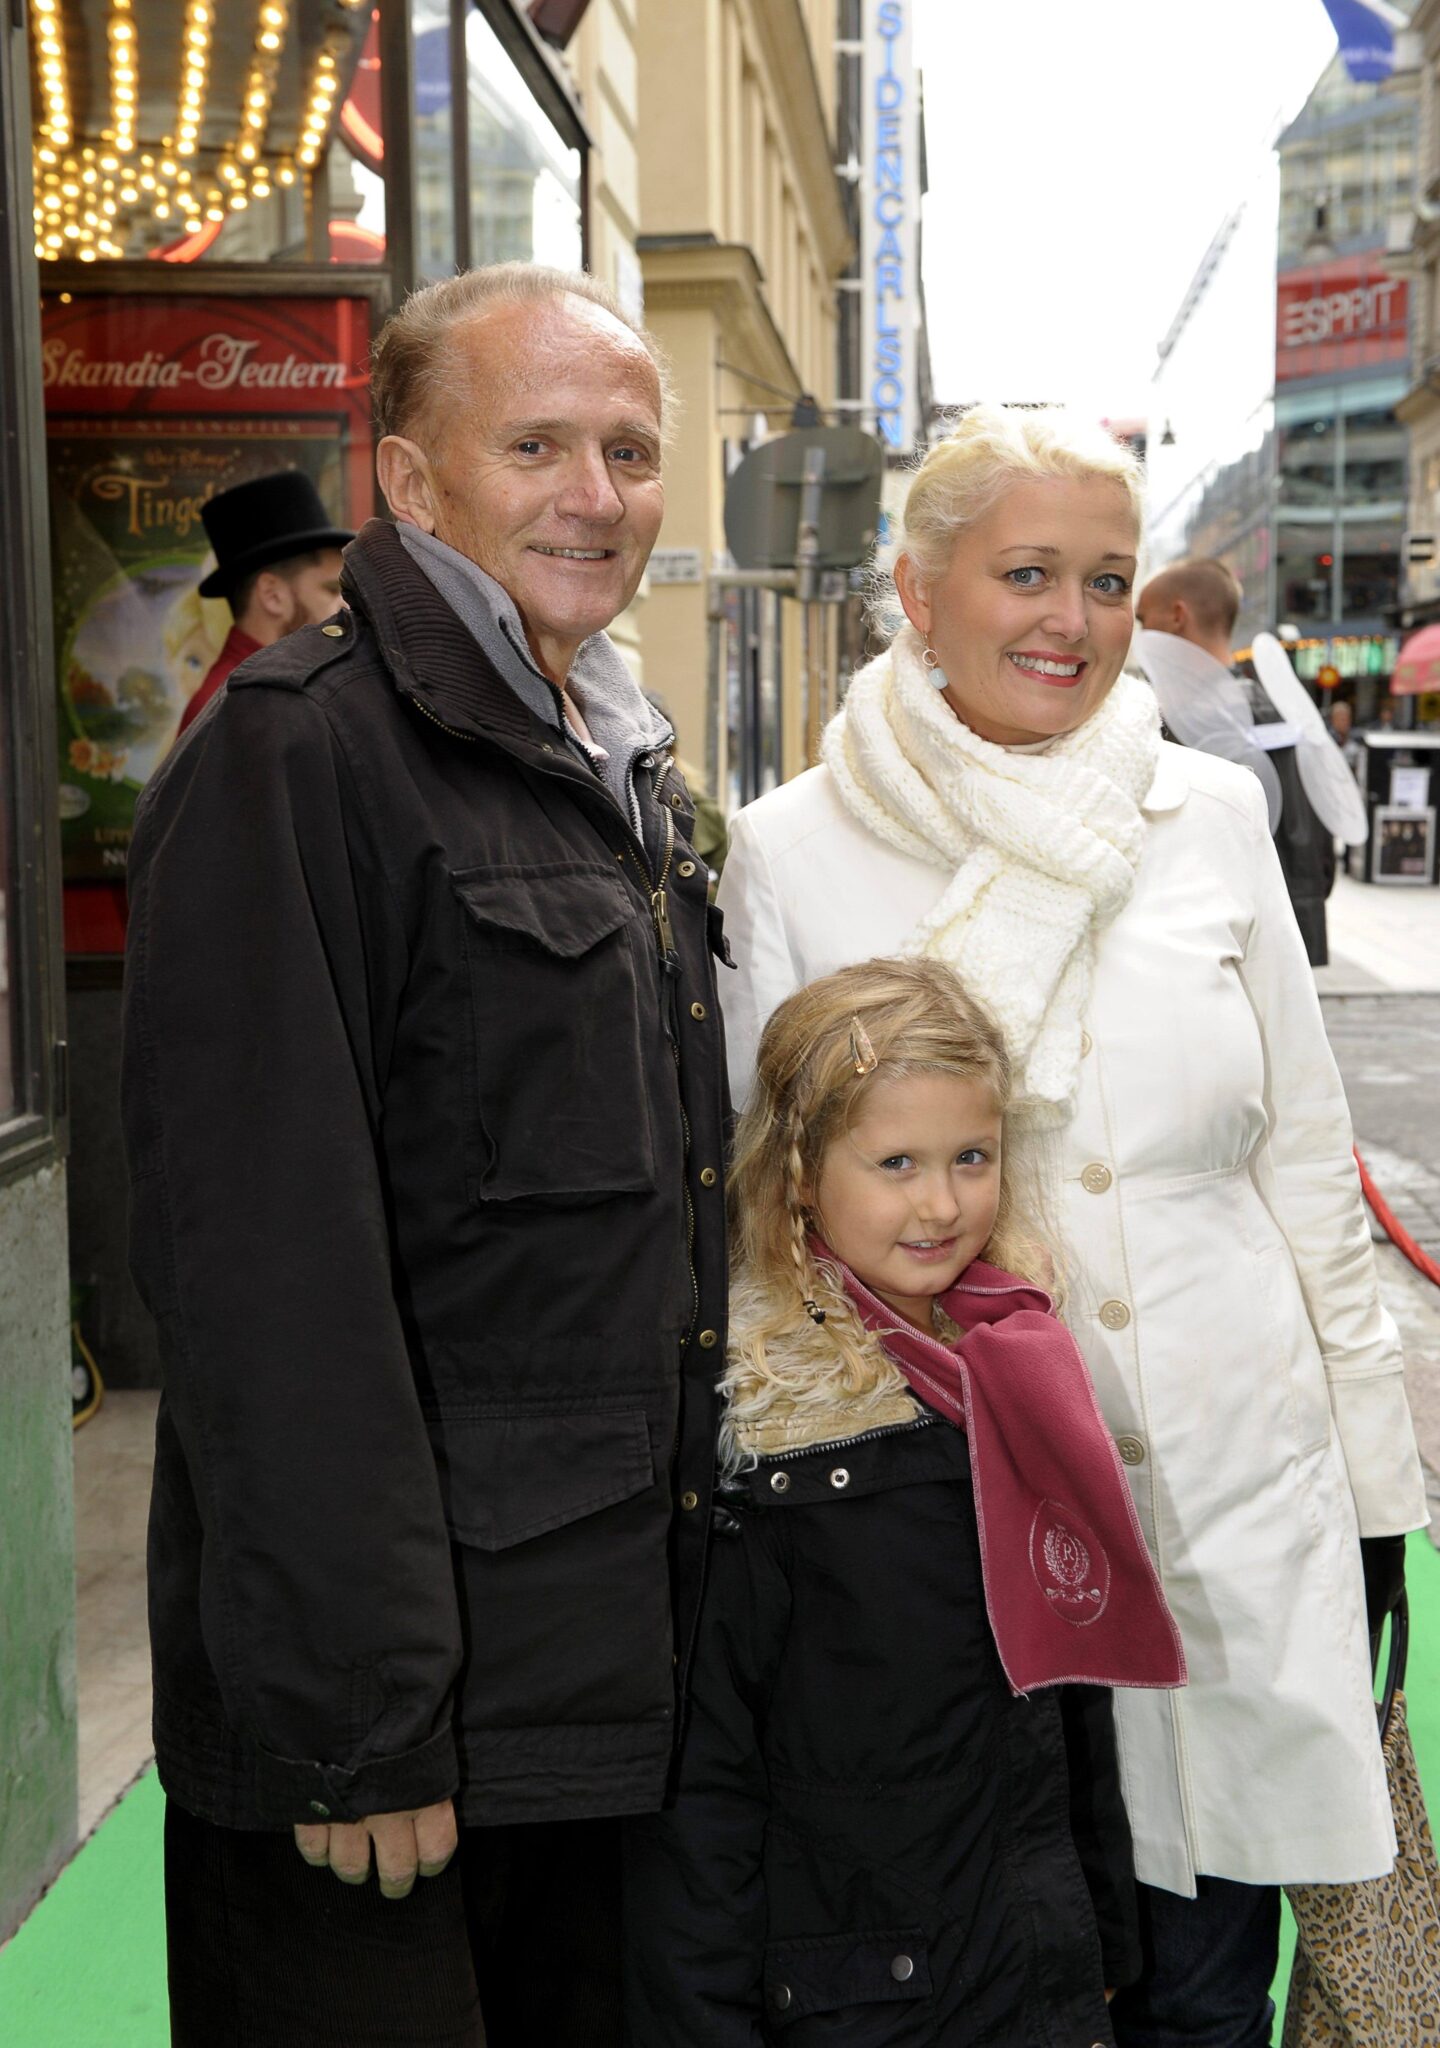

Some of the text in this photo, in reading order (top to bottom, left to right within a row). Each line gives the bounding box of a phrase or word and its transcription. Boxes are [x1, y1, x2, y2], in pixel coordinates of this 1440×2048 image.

[873, 2, 905, 449] SIDENCARLSON
[1285, 280, 1398, 345] ESPRIT
[43, 333, 346, 388] Skandia-Teatern
[1063, 1543, 1074, 1561] R
